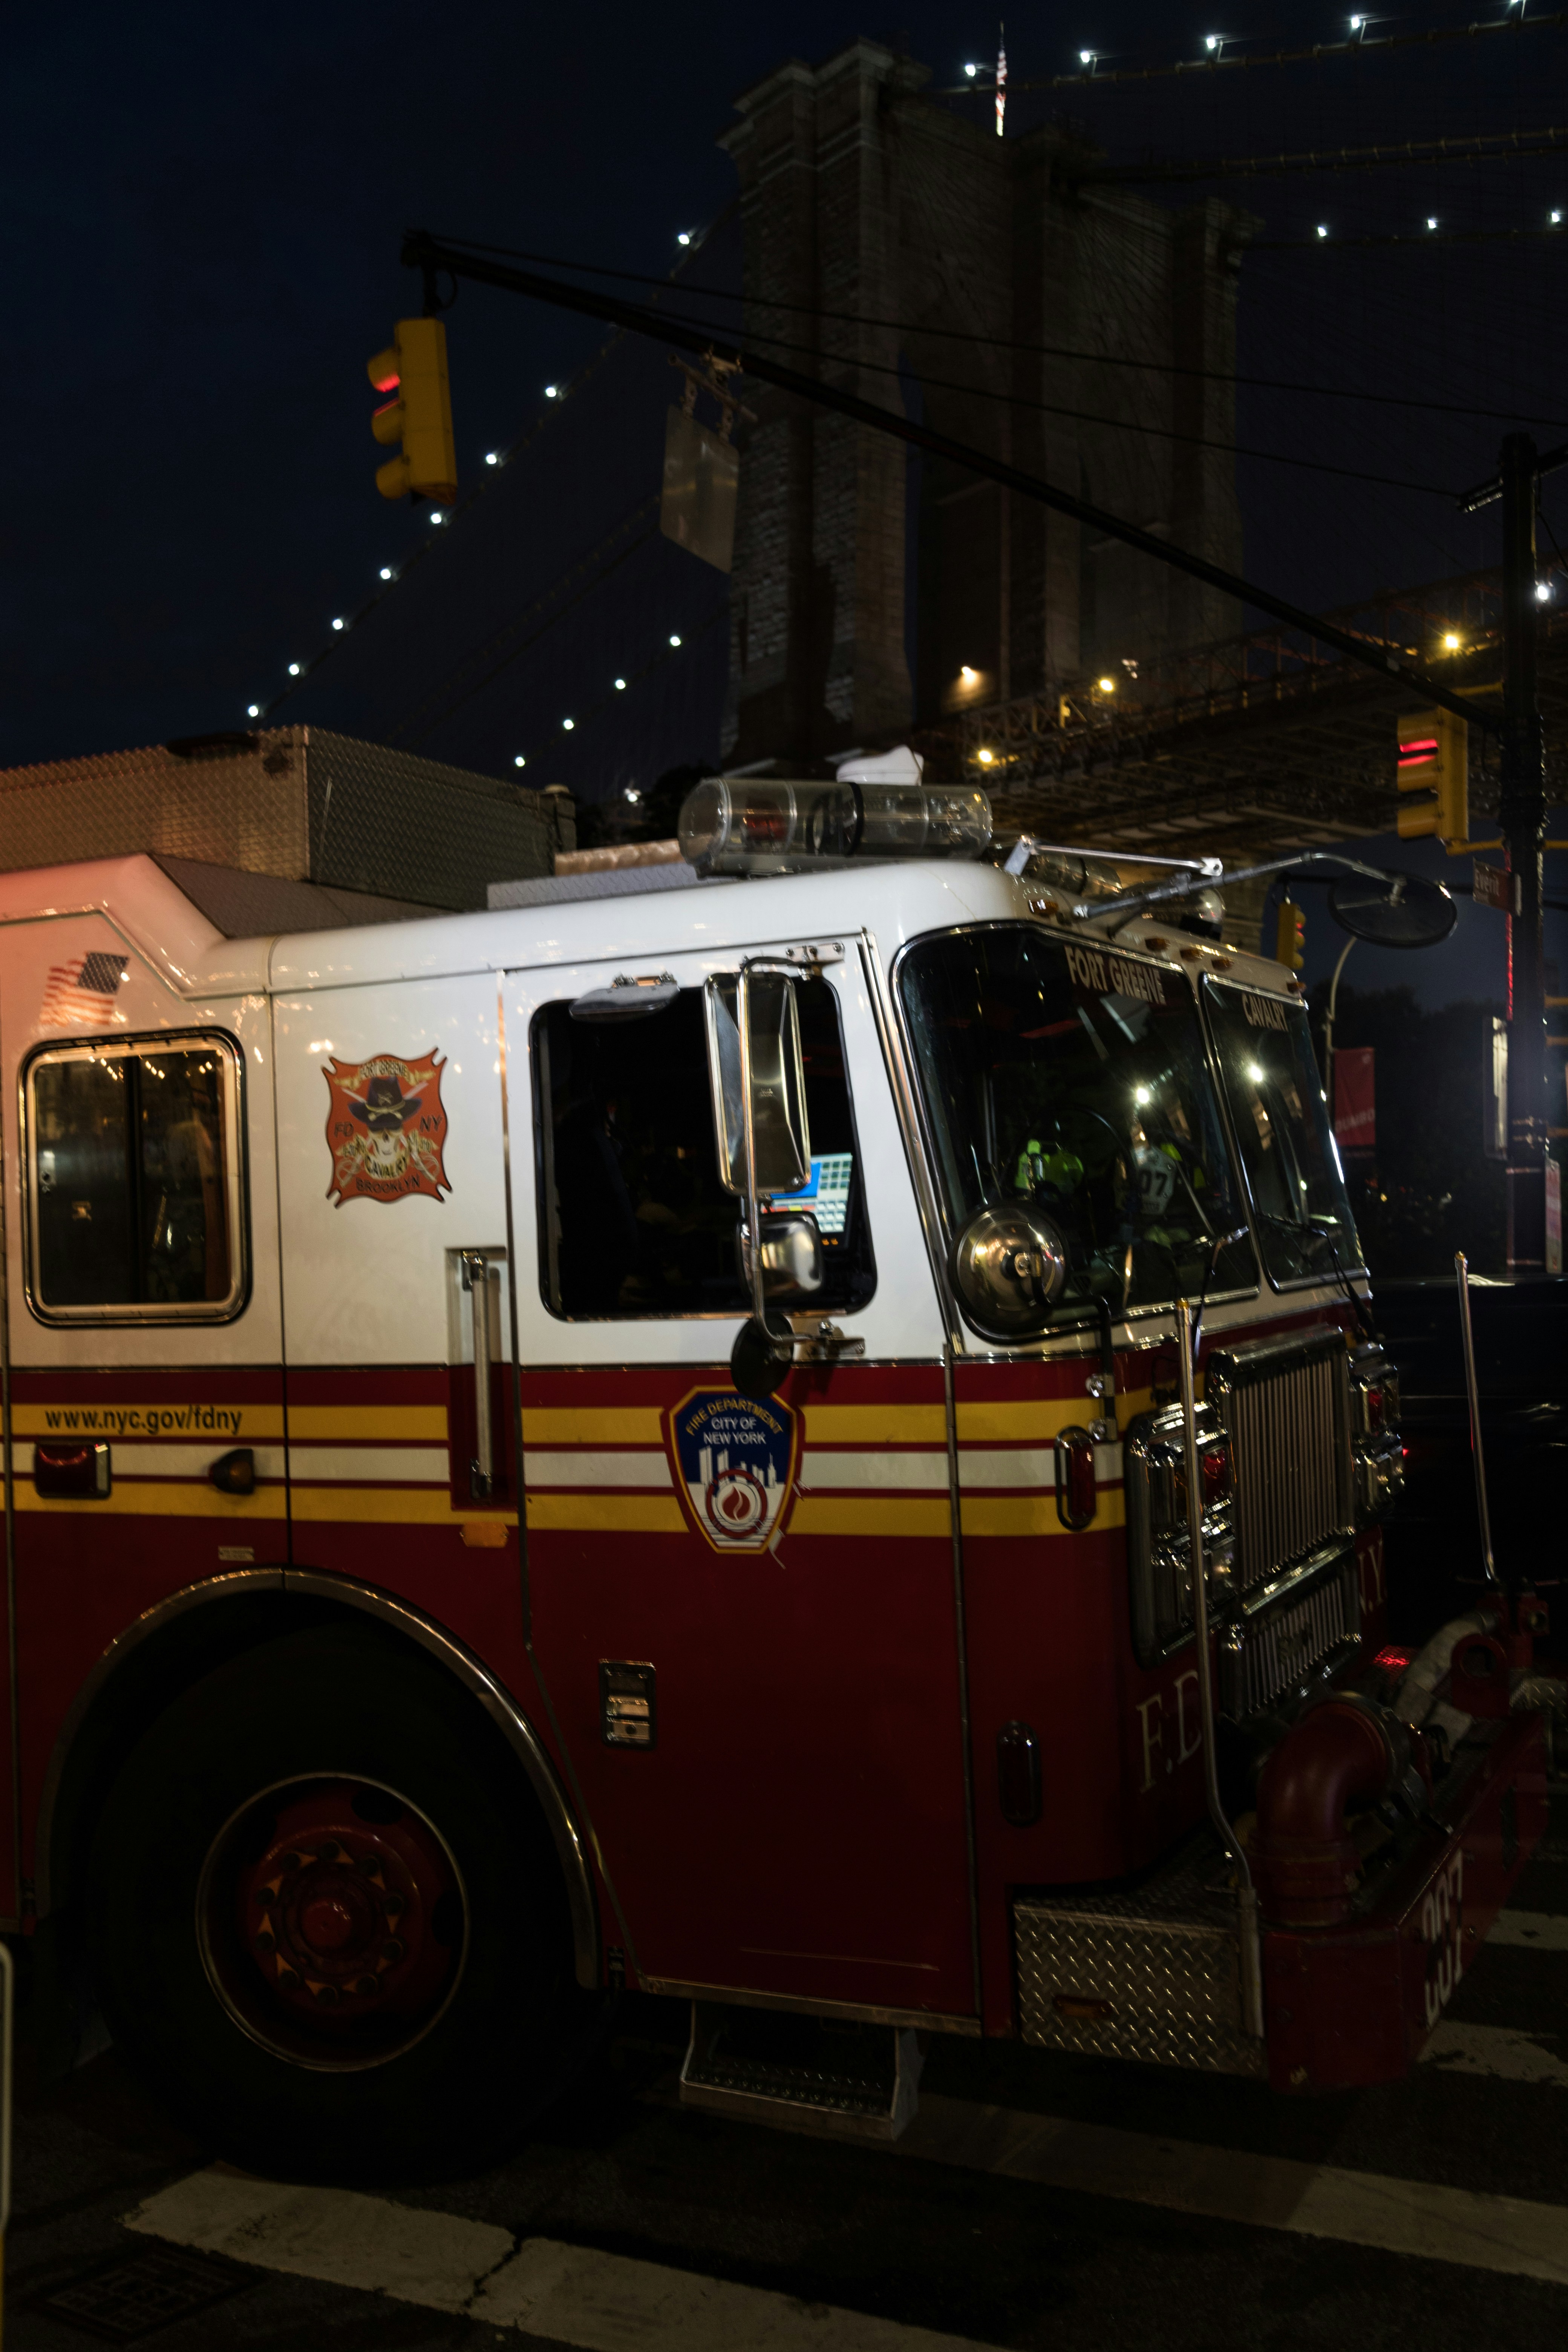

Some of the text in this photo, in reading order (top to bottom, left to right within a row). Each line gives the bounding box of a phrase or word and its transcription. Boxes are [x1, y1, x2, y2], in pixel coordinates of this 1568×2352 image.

[1064, 944, 1168, 1006] FORT GREENE
[1241, 992, 1289, 1032] CAVALRY
[334, 1115, 443, 1138] FD NY
[365, 1153, 407, 1178] CAVALRY
[356, 1173, 420, 1193] BROOKLYN
[45, 1404, 243, 1435] www.nyc.gov/fdny
[685, 1397, 784, 1437] FIRE DEPARTMENT
[711, 1416, 757, 1430] CITY OF
[703, 1431, 767, 1445] NEW YORK
[1421, 1847, 1464, 2033] 207
